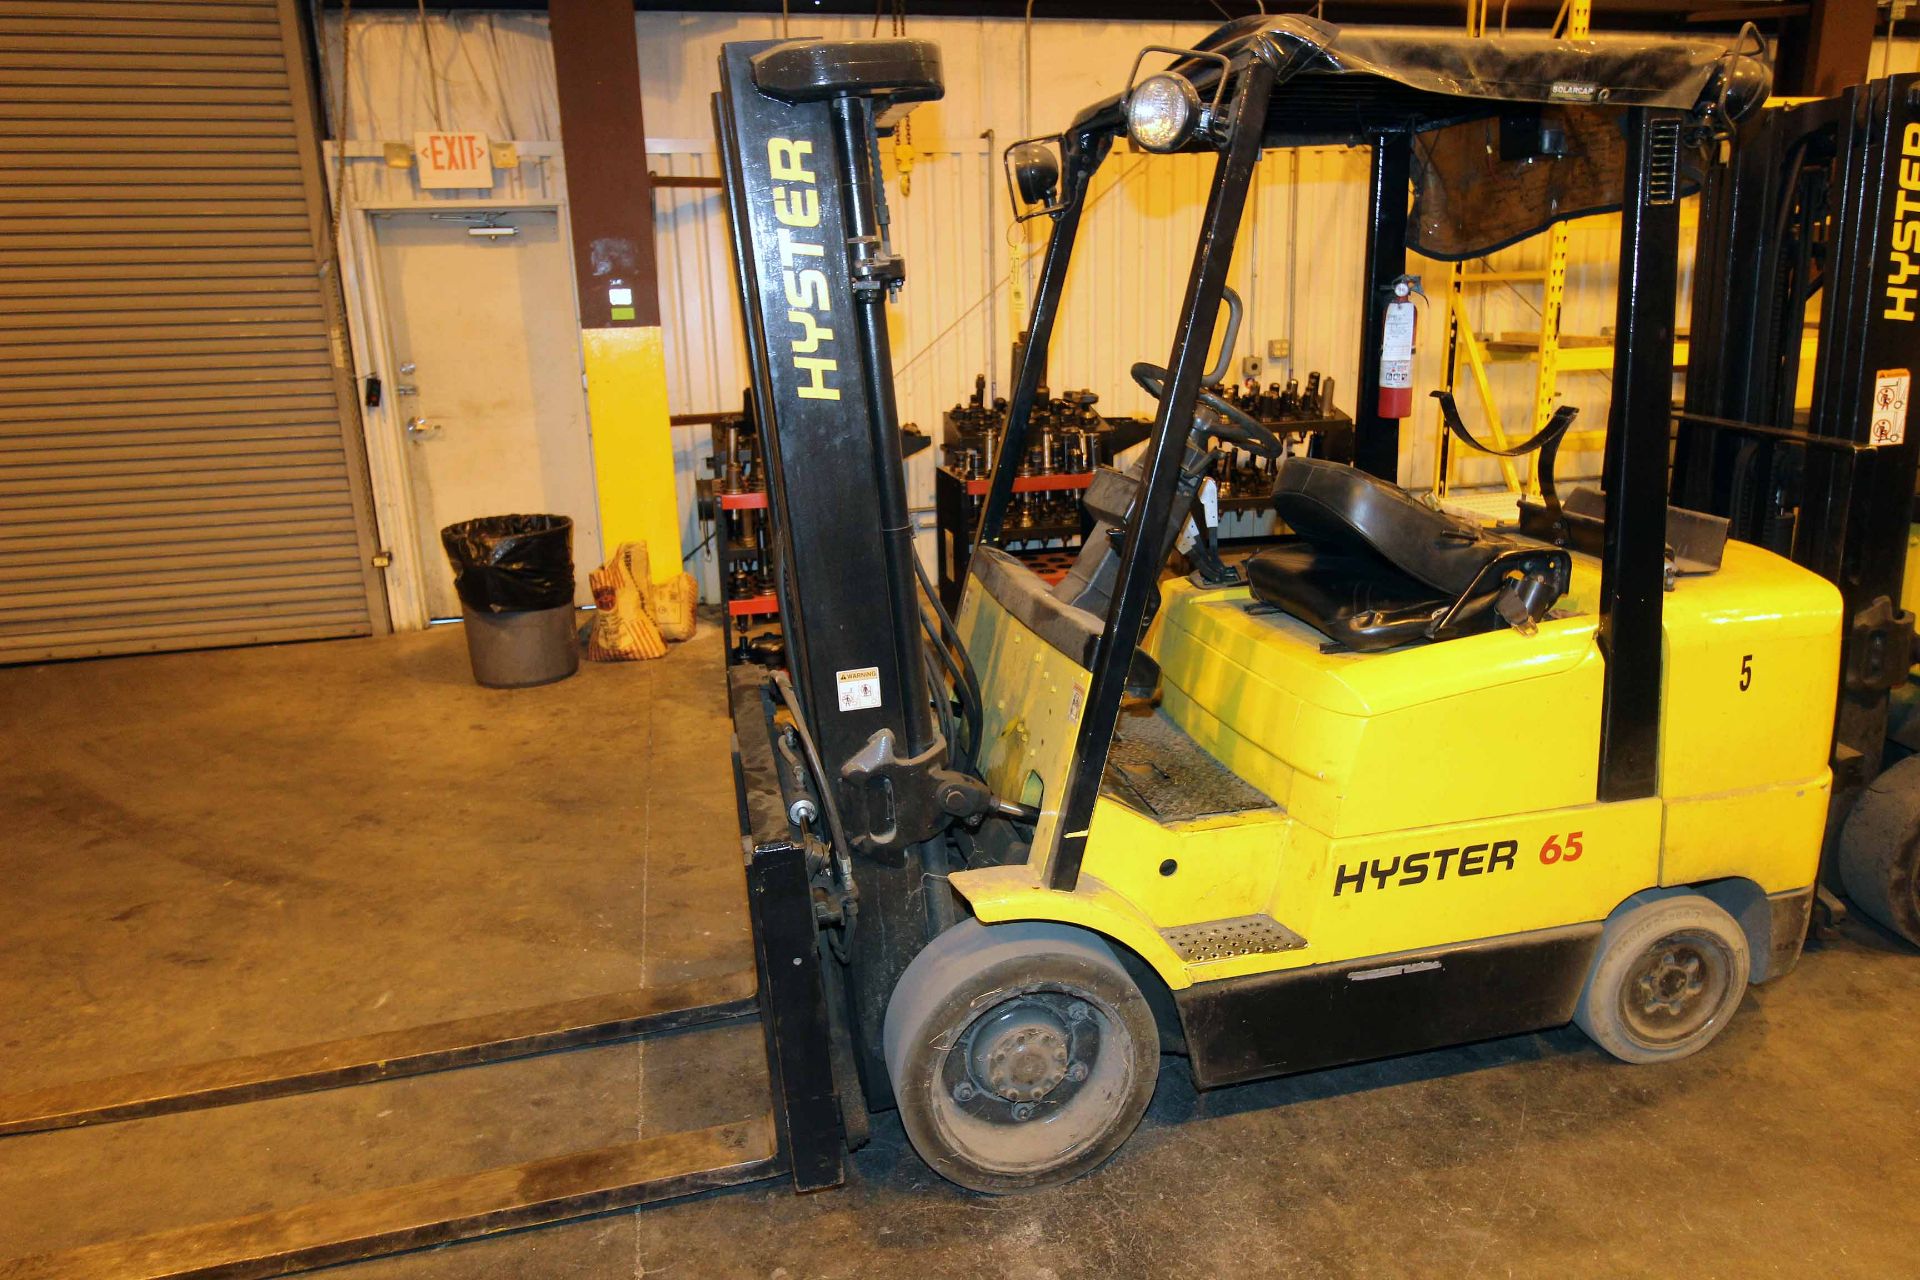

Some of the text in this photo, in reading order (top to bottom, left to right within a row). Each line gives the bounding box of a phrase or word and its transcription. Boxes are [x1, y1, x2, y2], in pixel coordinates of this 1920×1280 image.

[1552, 85, 1594, 95] SOLARCAP
[429, 135, 478, 170] EXIT
[767, 137, 841, 401] HYSTER
[847, 670, 876, 680] WARNING
[1739, 654, 1753, 692] 5
[1333, 831, 1583, 897] HYSTER 65
